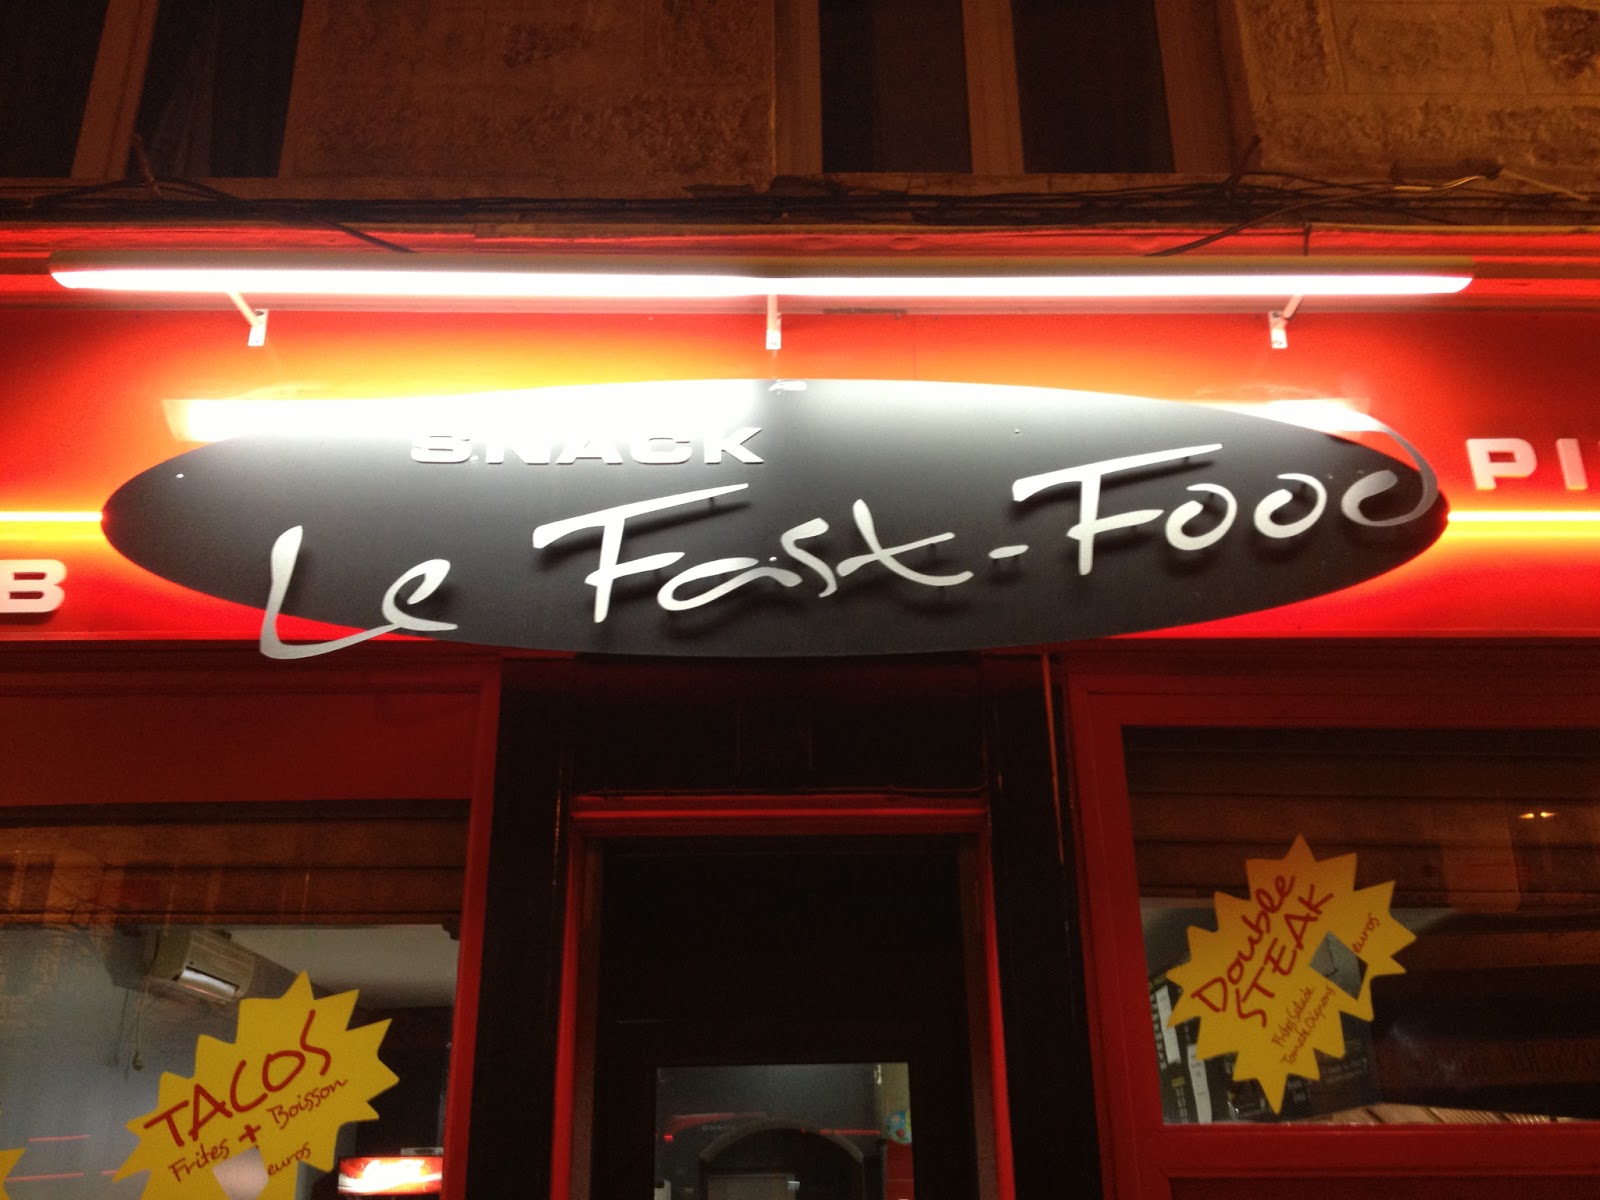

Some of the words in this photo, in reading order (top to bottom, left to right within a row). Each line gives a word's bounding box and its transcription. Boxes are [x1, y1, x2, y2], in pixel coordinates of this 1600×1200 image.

[410, 427, 765, 464] SNACK
[0, 558, 67, 613] B
[259, 525, 457, 660] Le
[1191, 874, 1296, 1013] Double
[1237, 884, 1334, 1028] STEAK
[1352, 912, 1380, 953] euros
[143, 1009, 331, 1147] TACOS
[168, 1138, 230, 1183] Frites
[266, 1078, 349, 1131] Boisson
[267, 1141, 312, 1177] euros
